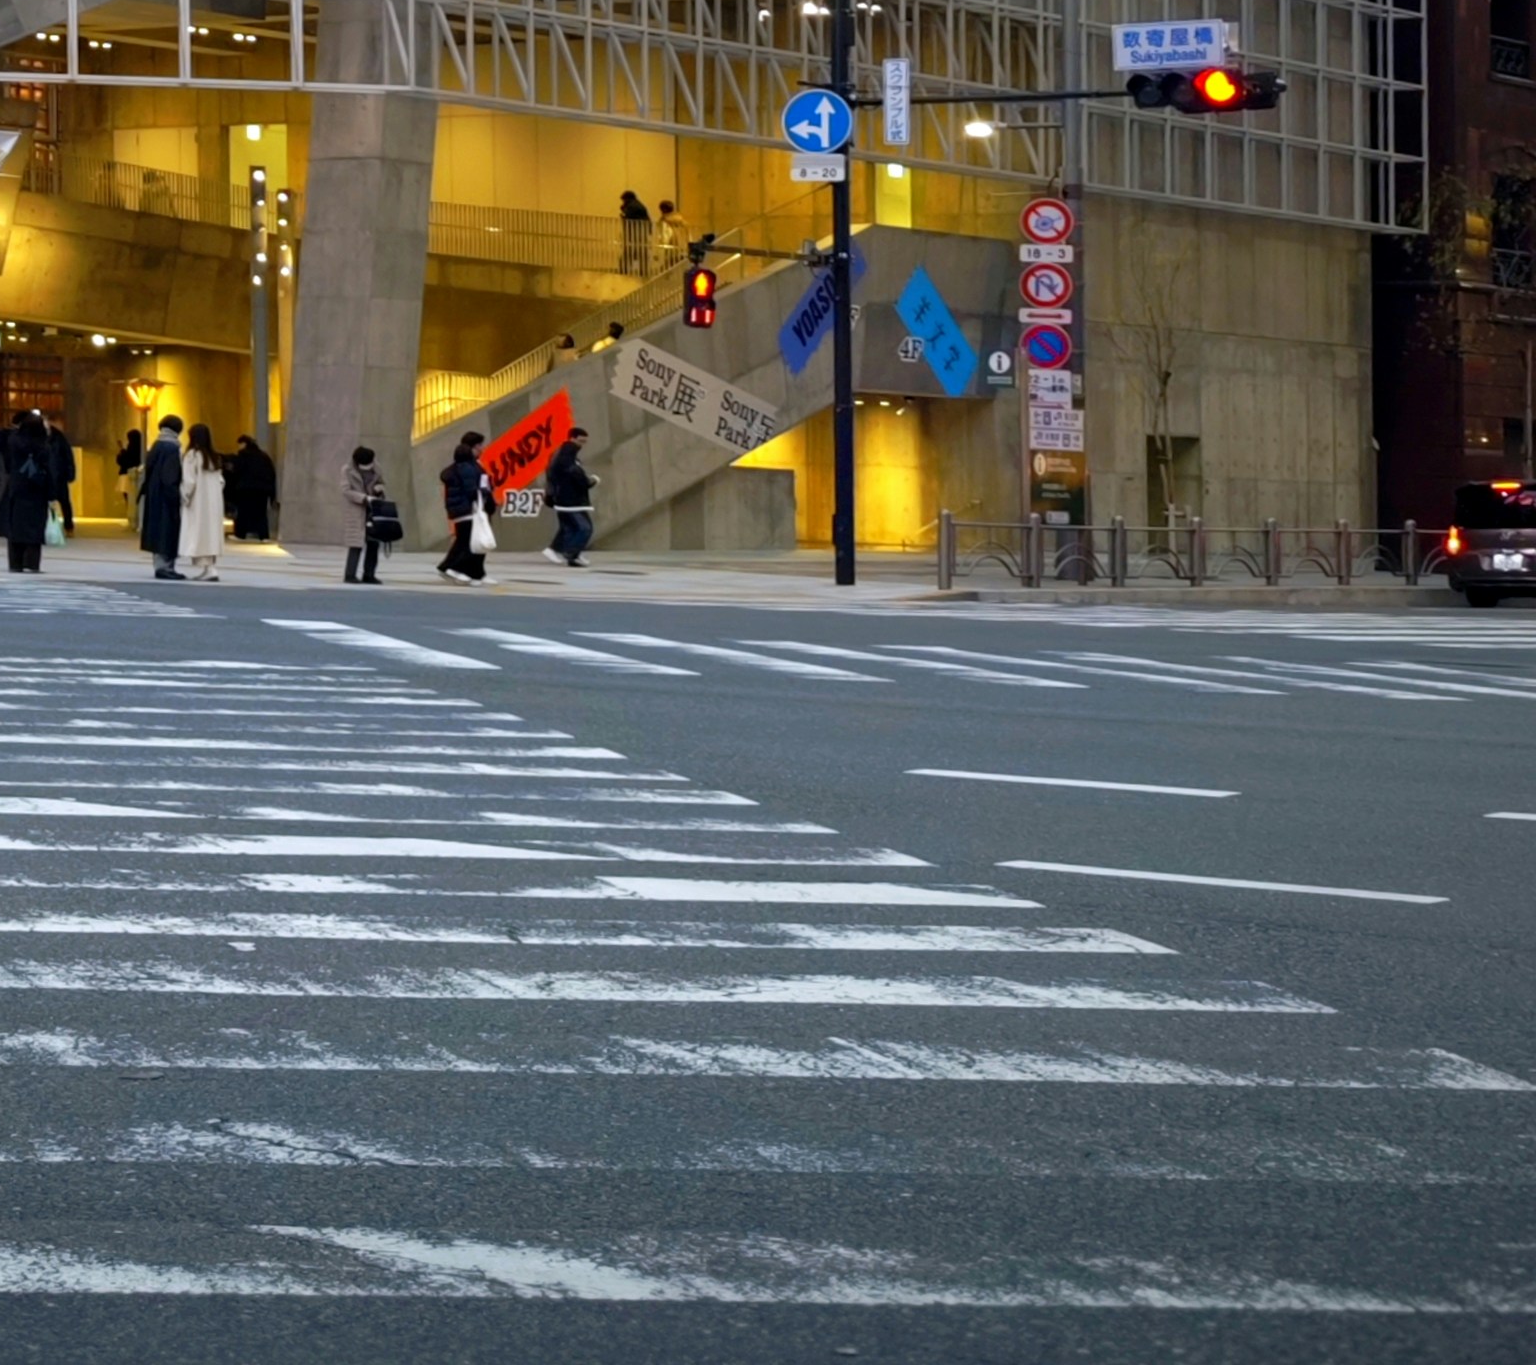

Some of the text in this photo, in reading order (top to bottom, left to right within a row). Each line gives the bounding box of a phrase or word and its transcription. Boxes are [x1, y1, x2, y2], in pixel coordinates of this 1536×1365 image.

[1123, 27, 1213, 48] 数寄屋橋
[1130, 48, 1207, 65] Sukiyabashi
[792, 273, 835, 347] YOASO
[636, 348, 677, 387] Sony
[629, 375, 668, 411] Park
[720, 390, 759, 429] Sony
[489, 415, 553, 487] UNDY
[714, 416, 752, 450] Park
[504, 491, 544, 515] B2F
